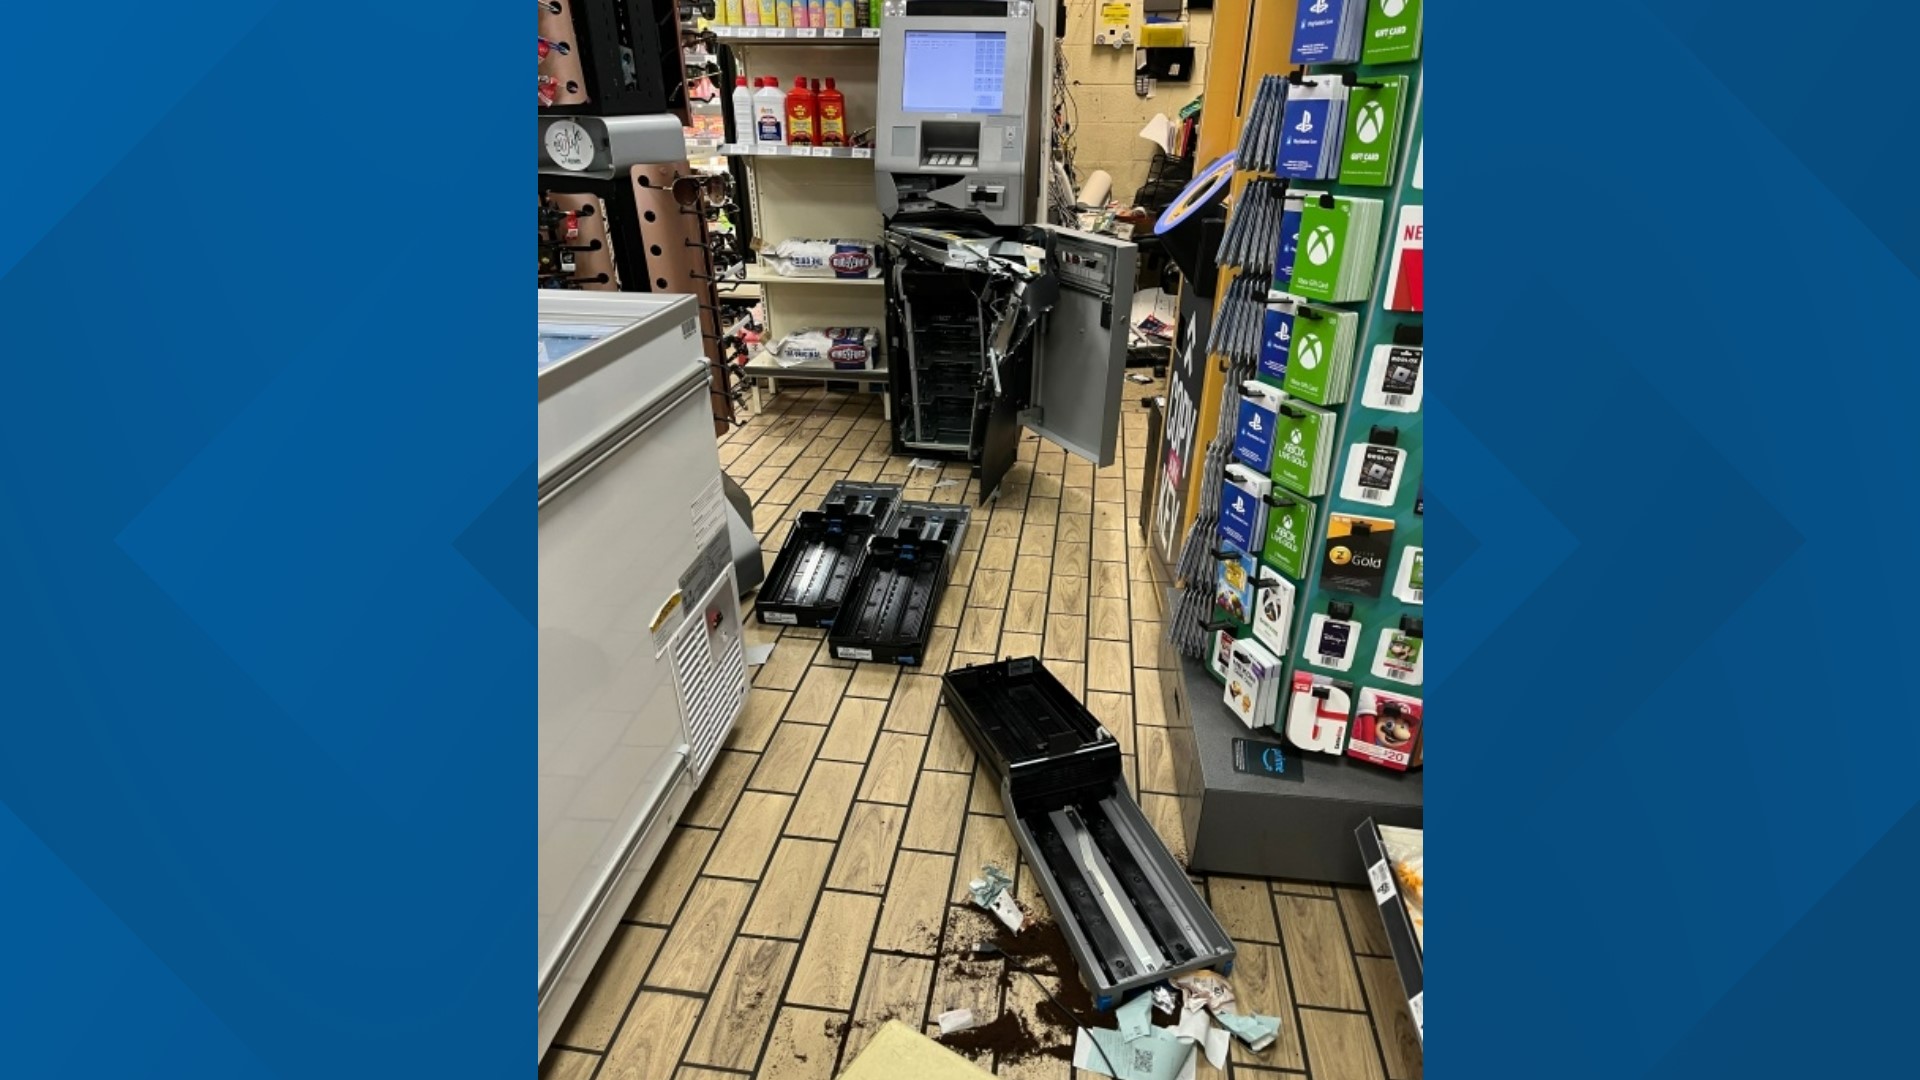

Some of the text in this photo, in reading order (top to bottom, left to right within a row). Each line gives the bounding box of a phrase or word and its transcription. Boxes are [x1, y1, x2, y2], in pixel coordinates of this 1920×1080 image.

[1375, 26, 1407, 38] GIFT CARD
[1350, 153, 1380, 161] GIFT CARD
[1391, 356, 1418, 364] ROBLOX
[1167, 370, 1197, 478] COPY
[1284, 441, 1305, 457] XBOX
[1279, 449, 1308, 468] LIVE GOLD
[1367, 453, 1394, 462] ROBLOX
[1157, 462, 1180, 562] KEY
[1275, 525, 1296, 544] XBOX
[1352, 554, 1381, 569] Gold
